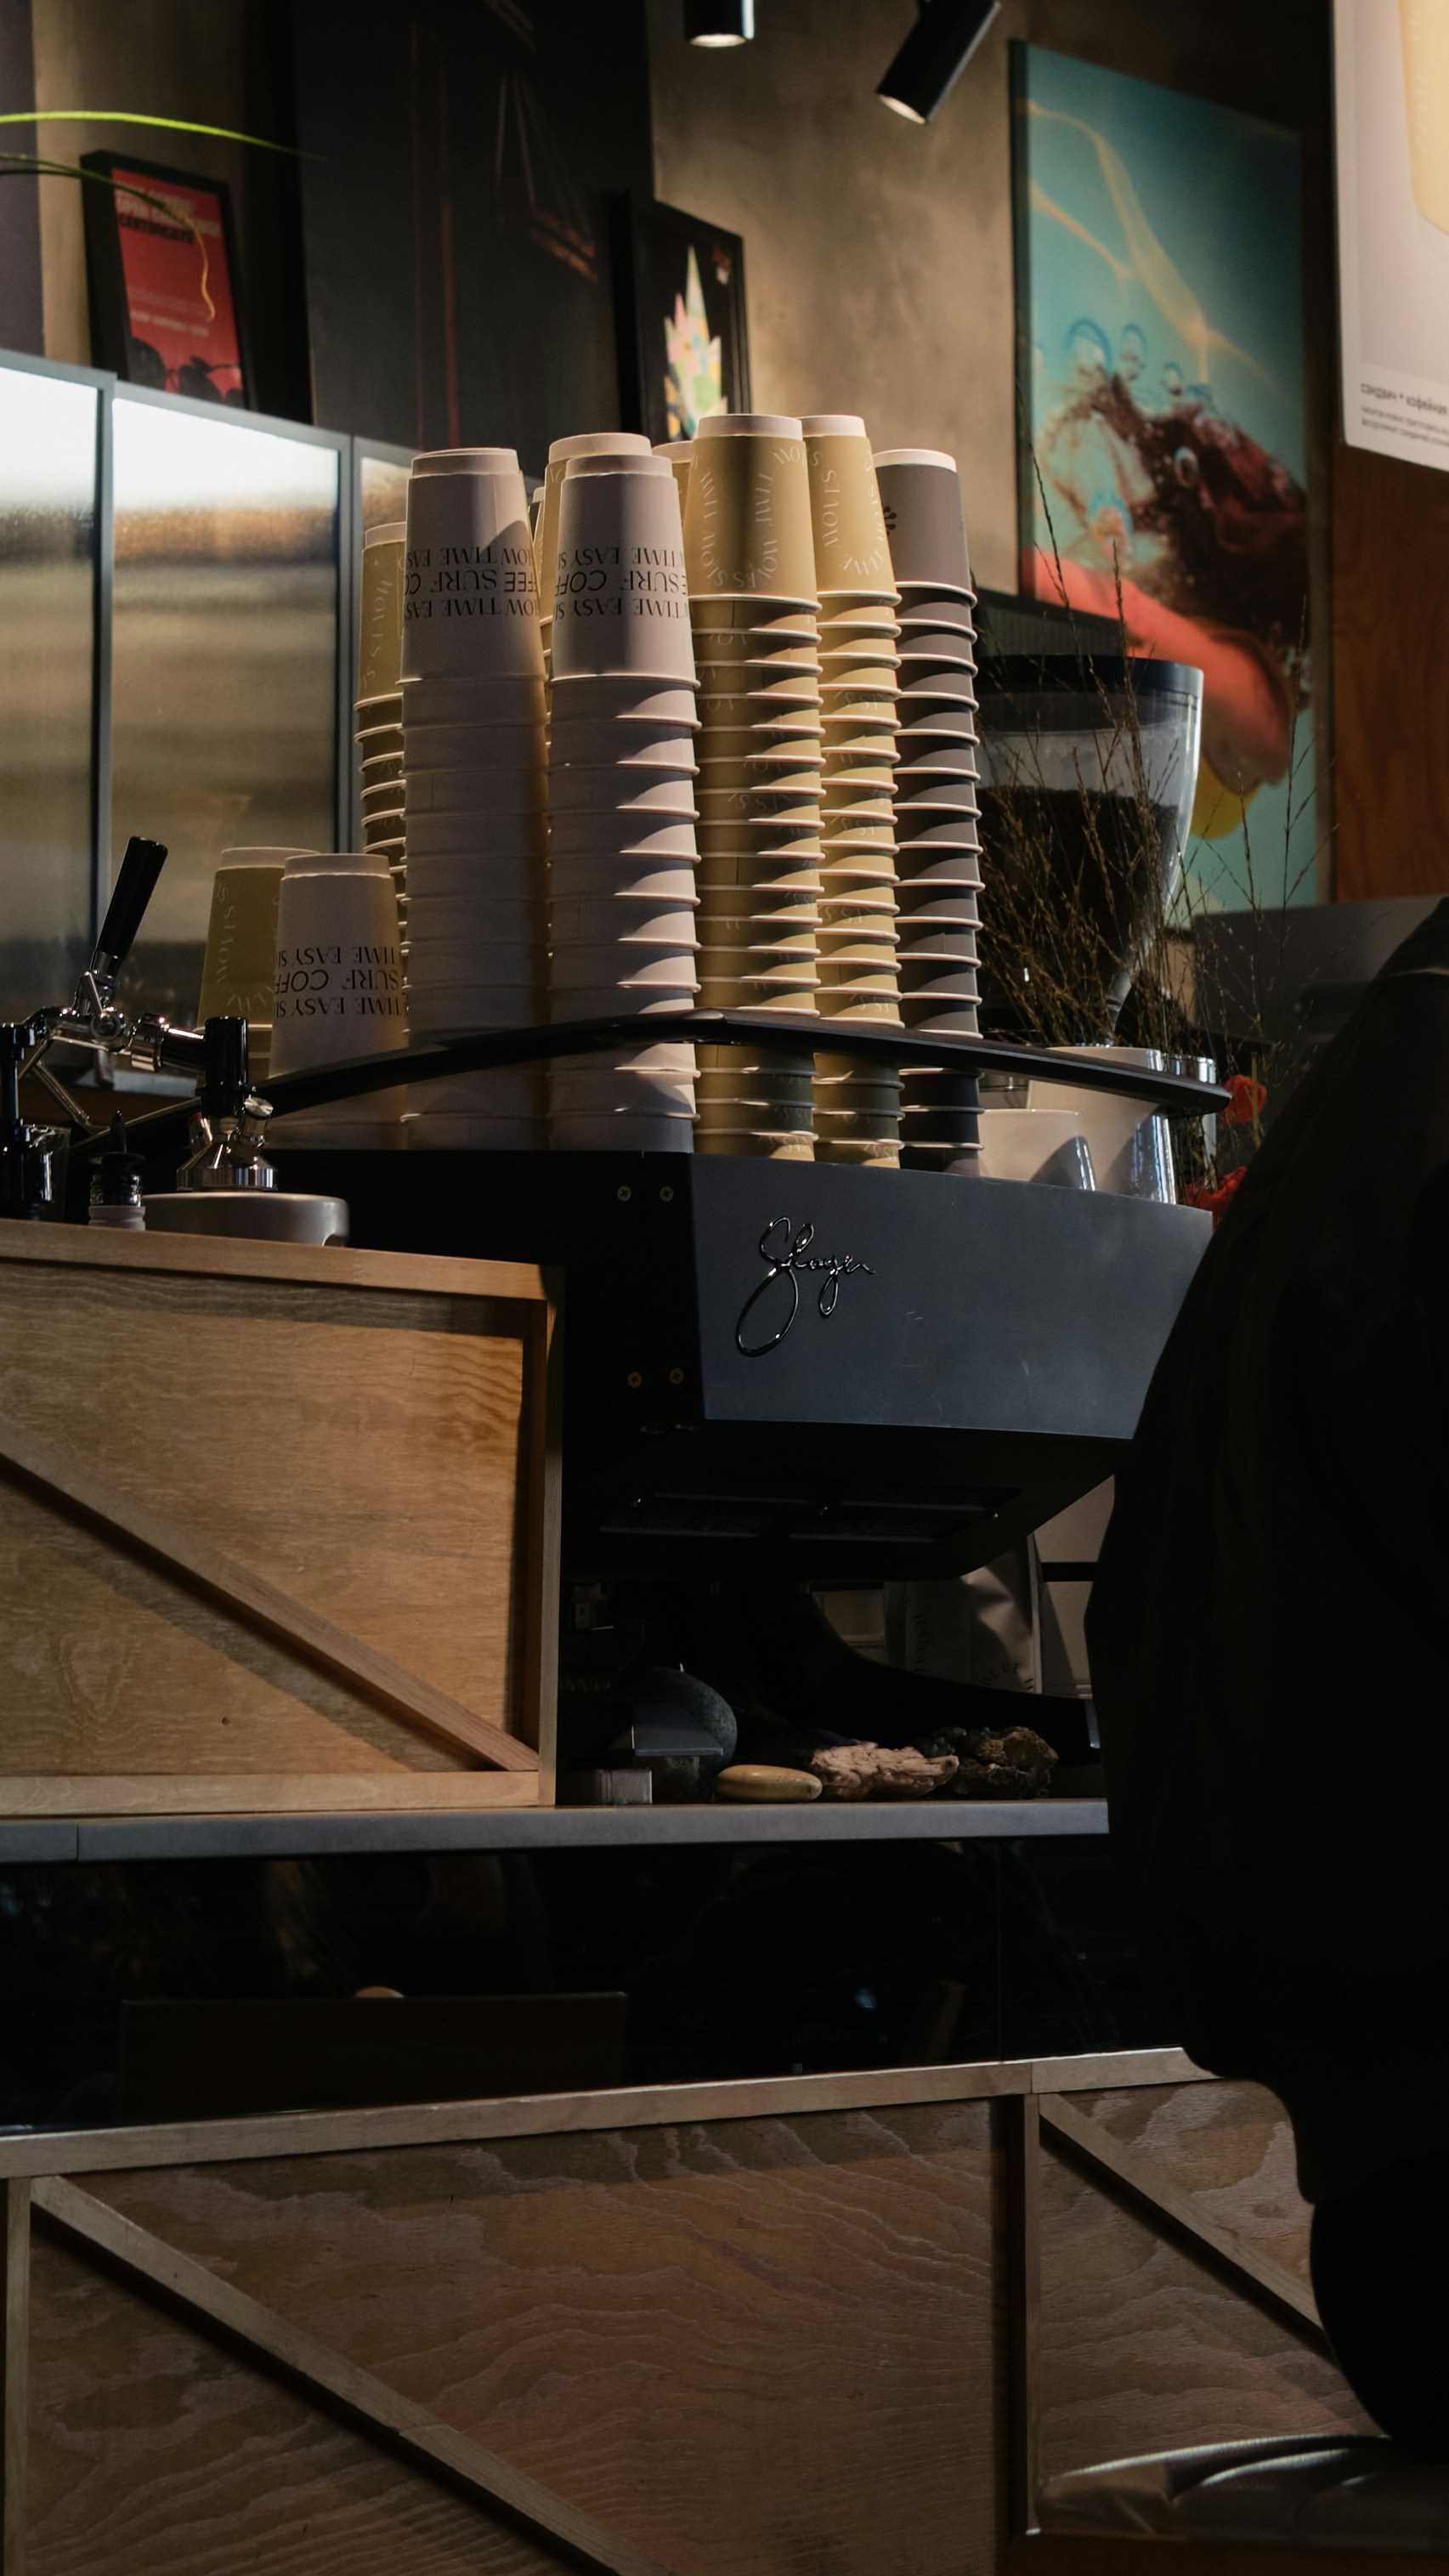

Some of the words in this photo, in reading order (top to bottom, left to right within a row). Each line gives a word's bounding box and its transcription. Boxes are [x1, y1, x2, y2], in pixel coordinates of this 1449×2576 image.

[406, 549, 431, 569] EAS
[440, 546, 497, 565] TIME
[570, 546, 620, 566] EASY
[631, 546, 675, 567] TIME
[430, 569, 497, 592] SURF
[554, 569, 607, 597] COFF
[620, 570, 679, 593] SURF
[405, 600, 433, 620] EAS
[441, 597, 502, 617] TIME
[569, 598, 623, 617] EASY
[632, 598, 679, 619] TIME
[291, 946, 342, 965] EASY
[353, 946, 396, 965] TIME
[275, 969, 330, 994] COFF
[342, 969, 399, 990] SURF
[291, 997, 345, 1016] EASY
[355, 997, 400, 1016] TIME
